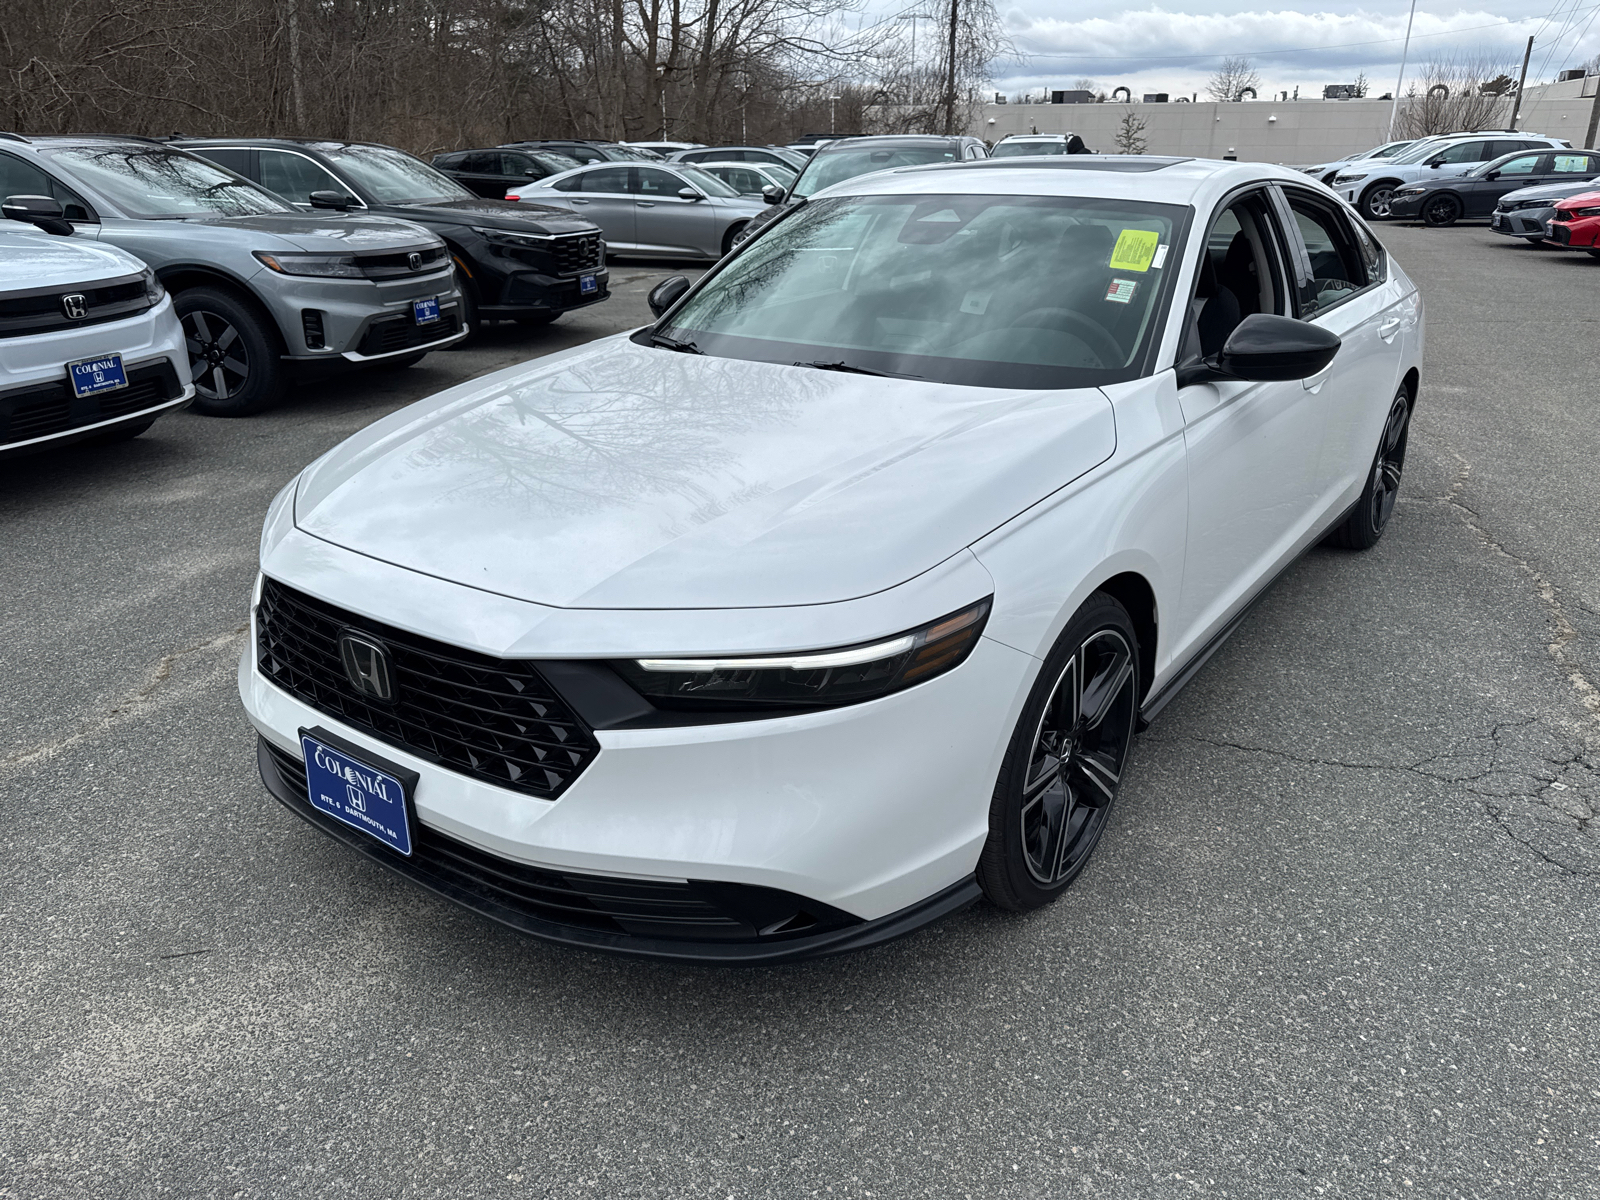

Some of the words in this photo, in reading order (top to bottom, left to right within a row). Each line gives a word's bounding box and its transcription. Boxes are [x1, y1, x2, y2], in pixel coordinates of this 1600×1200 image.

[76, 360, 116, 375] COLONIAL
[314, 750, 393, 804] COLONIAL
[320, 793, 335, 806] RTE.
[336, 801, 341, 809] 6
[387, 828, 398, 840] MA
